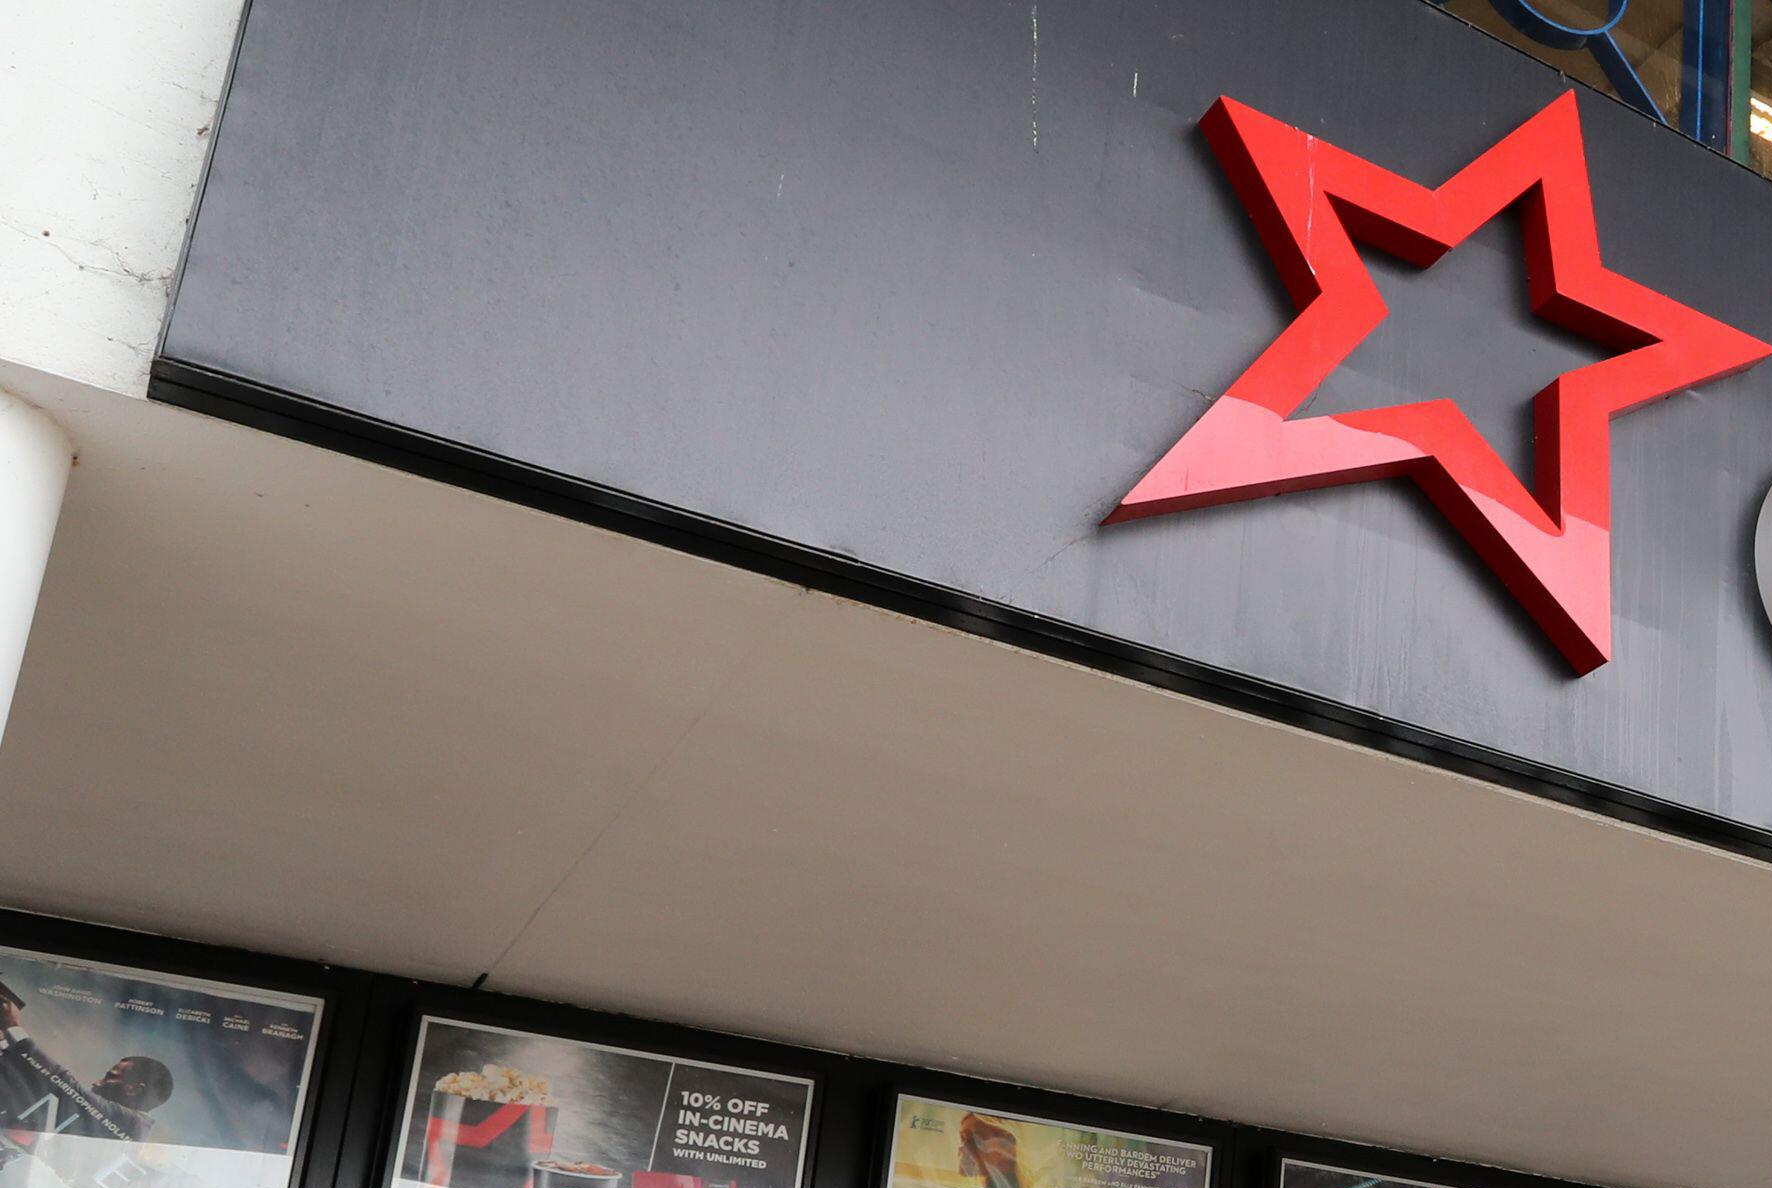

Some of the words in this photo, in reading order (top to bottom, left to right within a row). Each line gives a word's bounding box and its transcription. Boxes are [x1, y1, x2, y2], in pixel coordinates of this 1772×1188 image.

[39, 987, 102, 1004] WASHINGTON
[114, 1002, 165, 1016] PATTINSON
[176, 1013, 211, 1024] DEBICKI
[222, 1021, 250, 1032] CAINE
[262, 1028, 304, 1041] BRANAGH
[50, 1074, 103, 1123] CHRISTOPHER
[681, 1091, 721, 1111] 10%
[727, 1099, 770, 1117] OFF
[678, 1110, 789, 1140] IN-CINEMA
[675, 1129, 760, 1155] SNACKS
[673, 1148, 704, 1161] WITH
[706, 1152, 767, 1169] UNLIMITED
[1086, 1153, 1125, 1166] UTTERLY
[1127, 1159, 1186, 1175] DEVASTATING
[1099, 1145, 1118, 1158] AND
[1120, 1149, 1157, 1163] BARDEM
[1159, 1156, 1197, 1169] DELIVER
